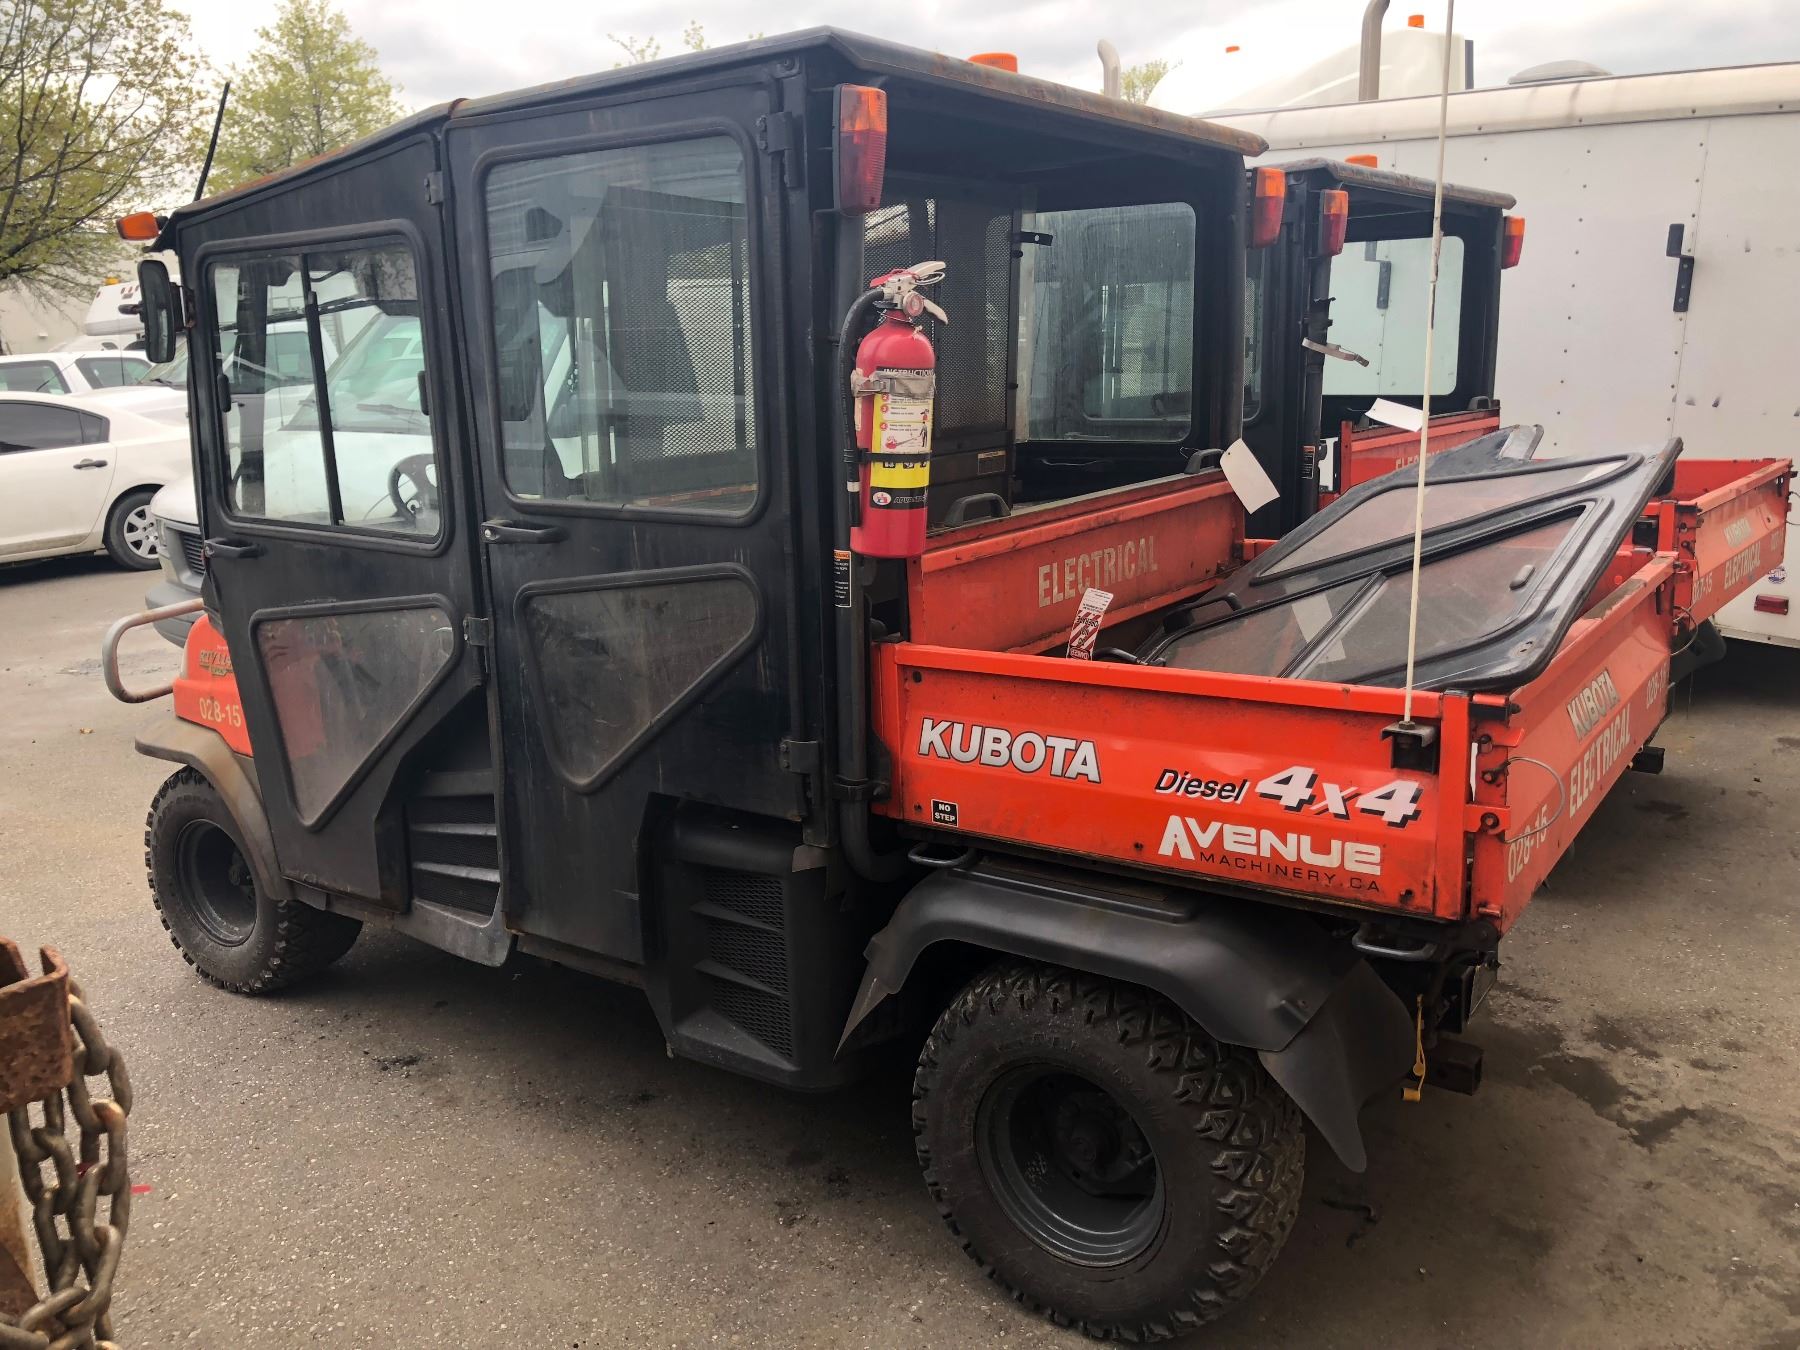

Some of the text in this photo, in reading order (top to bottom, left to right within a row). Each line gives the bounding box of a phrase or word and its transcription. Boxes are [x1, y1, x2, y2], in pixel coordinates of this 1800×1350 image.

[1038, 535, 1158, 608] ELECTRICAL
[199, 697, 242, 728] 028-15
[1567, 668, 1620, 742] KUBOTA
[918, 717, 1101, 784] KUBOTA
[1569, 703, 1632, 818] ELECTRICAL
[934, 811, 956, 822] STEP
[938, 803, 951, 812] NO
[1155, 764, 1424, 829] Diesel 4x4
[1158, 814, 1382, 876] AVENUE
[1507, 803, 1548, 883] 028-15
